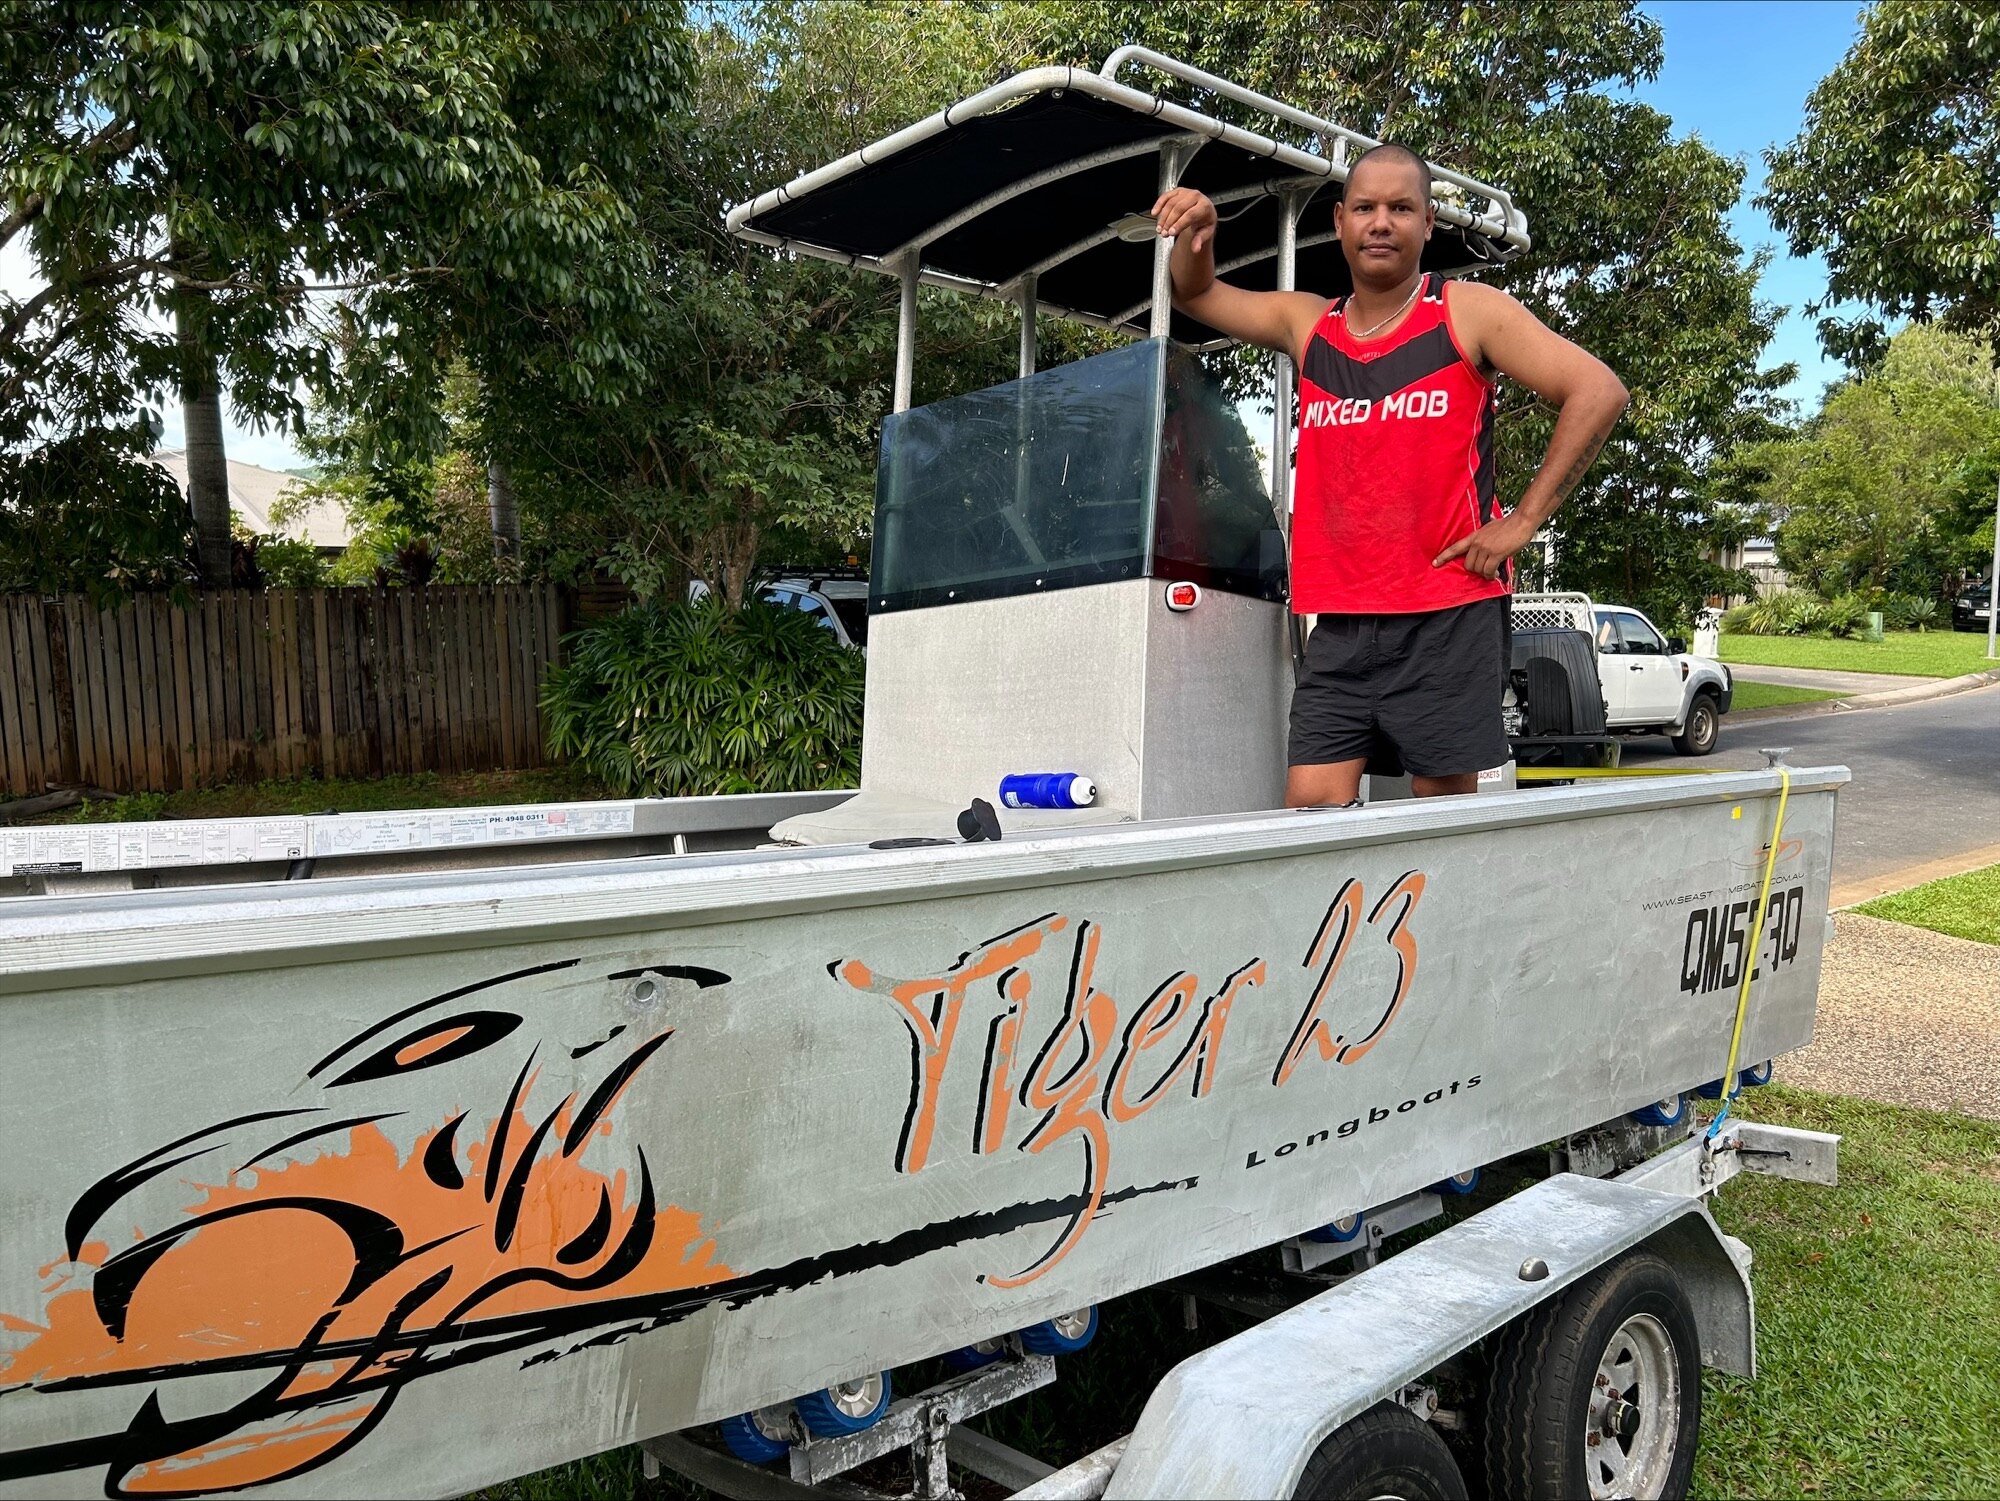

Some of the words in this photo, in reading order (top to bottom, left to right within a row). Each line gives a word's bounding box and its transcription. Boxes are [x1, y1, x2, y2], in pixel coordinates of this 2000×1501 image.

[1303, 397, 1372, 428] MIXED
[1381, 390, 1449, 422] MOB
[1478, 769, 1500, 780] ACKETS
[489, 816, 504, 824] PH:
[827, 911, 1267, 1288] Tiger
[1272, 869, 1426, 1088] 23
[1246, 1074, 1482, 1169] Longboats
